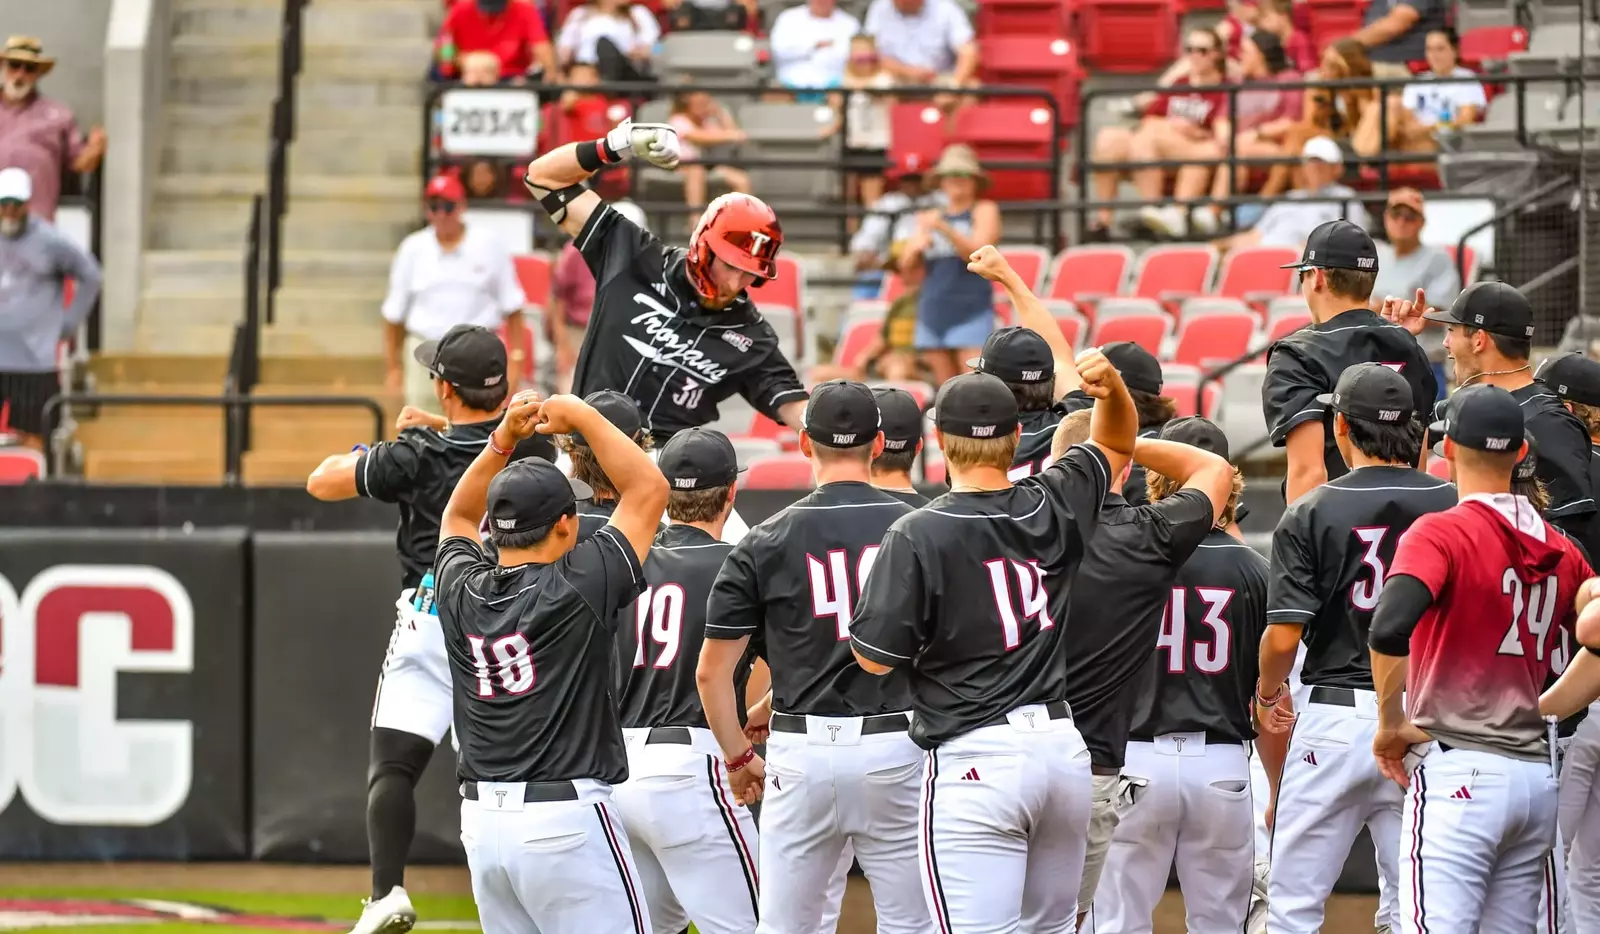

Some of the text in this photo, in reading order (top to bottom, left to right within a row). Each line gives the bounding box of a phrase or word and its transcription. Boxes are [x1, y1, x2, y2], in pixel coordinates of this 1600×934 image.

[751, 231, 771, 256] T
[1357, 257, 1375, 268] TROY
[630, 293, 728, 382] Trojans
[1022, 370, 1042, 381] TROY
[1378, 410, 1401, 421] TROY
[971, 425, 996, 437] TROY
[832, 433, 857, 444] TROY
[885, 439, 907, 450] TROY
[1486, 437, 1510, 449] TROY
[674, 477, 698, 488] TROY
[496, 519, 517, 530] TROY
[806, 545, 881, 641] 4
[983, 557, 1055, 651] 14
[1498, 567, 1558, 661] 24
[633, 582, 686, 669] 19
[1156, 586, 1236, 674] 43
[466, 632, 537, 698] 18
